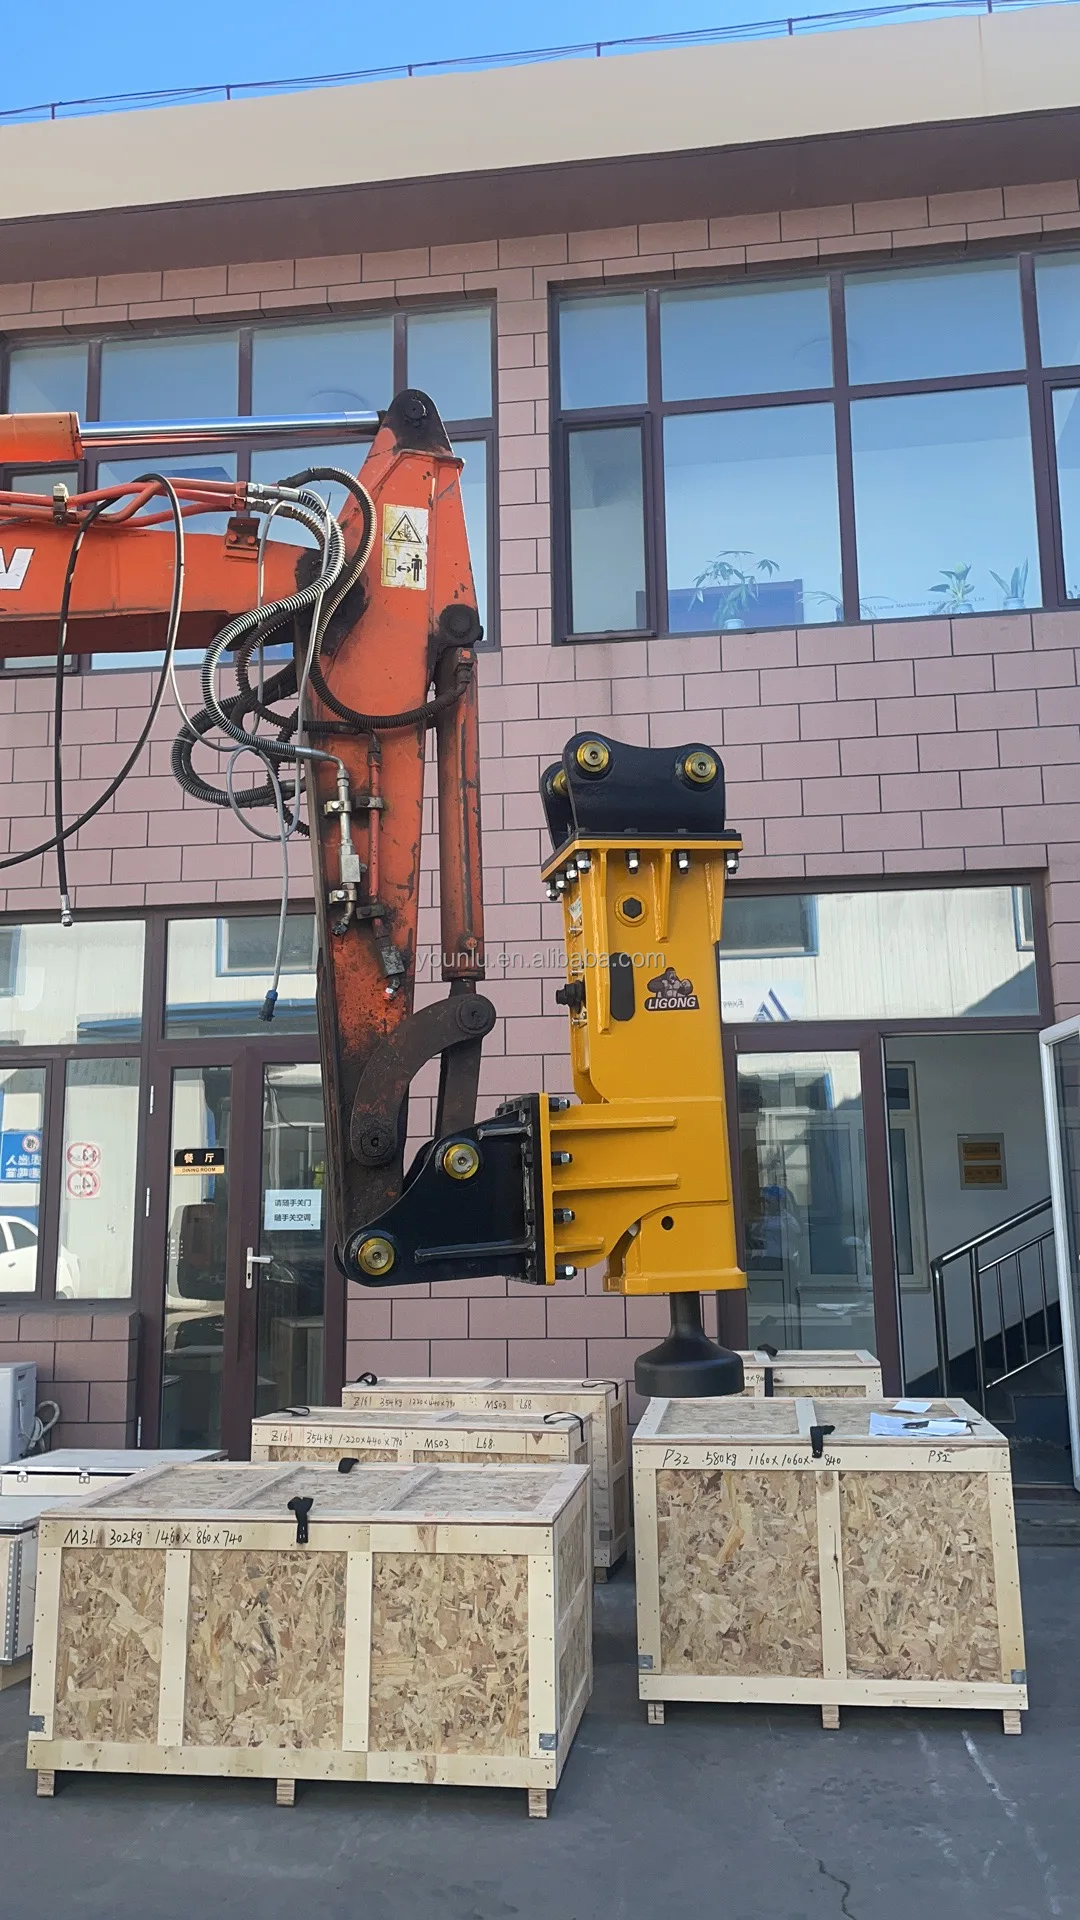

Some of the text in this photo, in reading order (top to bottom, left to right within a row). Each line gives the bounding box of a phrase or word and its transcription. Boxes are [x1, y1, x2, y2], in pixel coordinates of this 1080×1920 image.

[648, 998, 696, 1010] LIGONG
[183, 1152, 215, 1164] 餐厅
[274, 1199, 312, 1207] 请随手关门
[274, 1213, 311, 1221] 随手关空调
[662, 1449, 690, 1467] P32
[109, 1528, 143, 1546] 302kg
